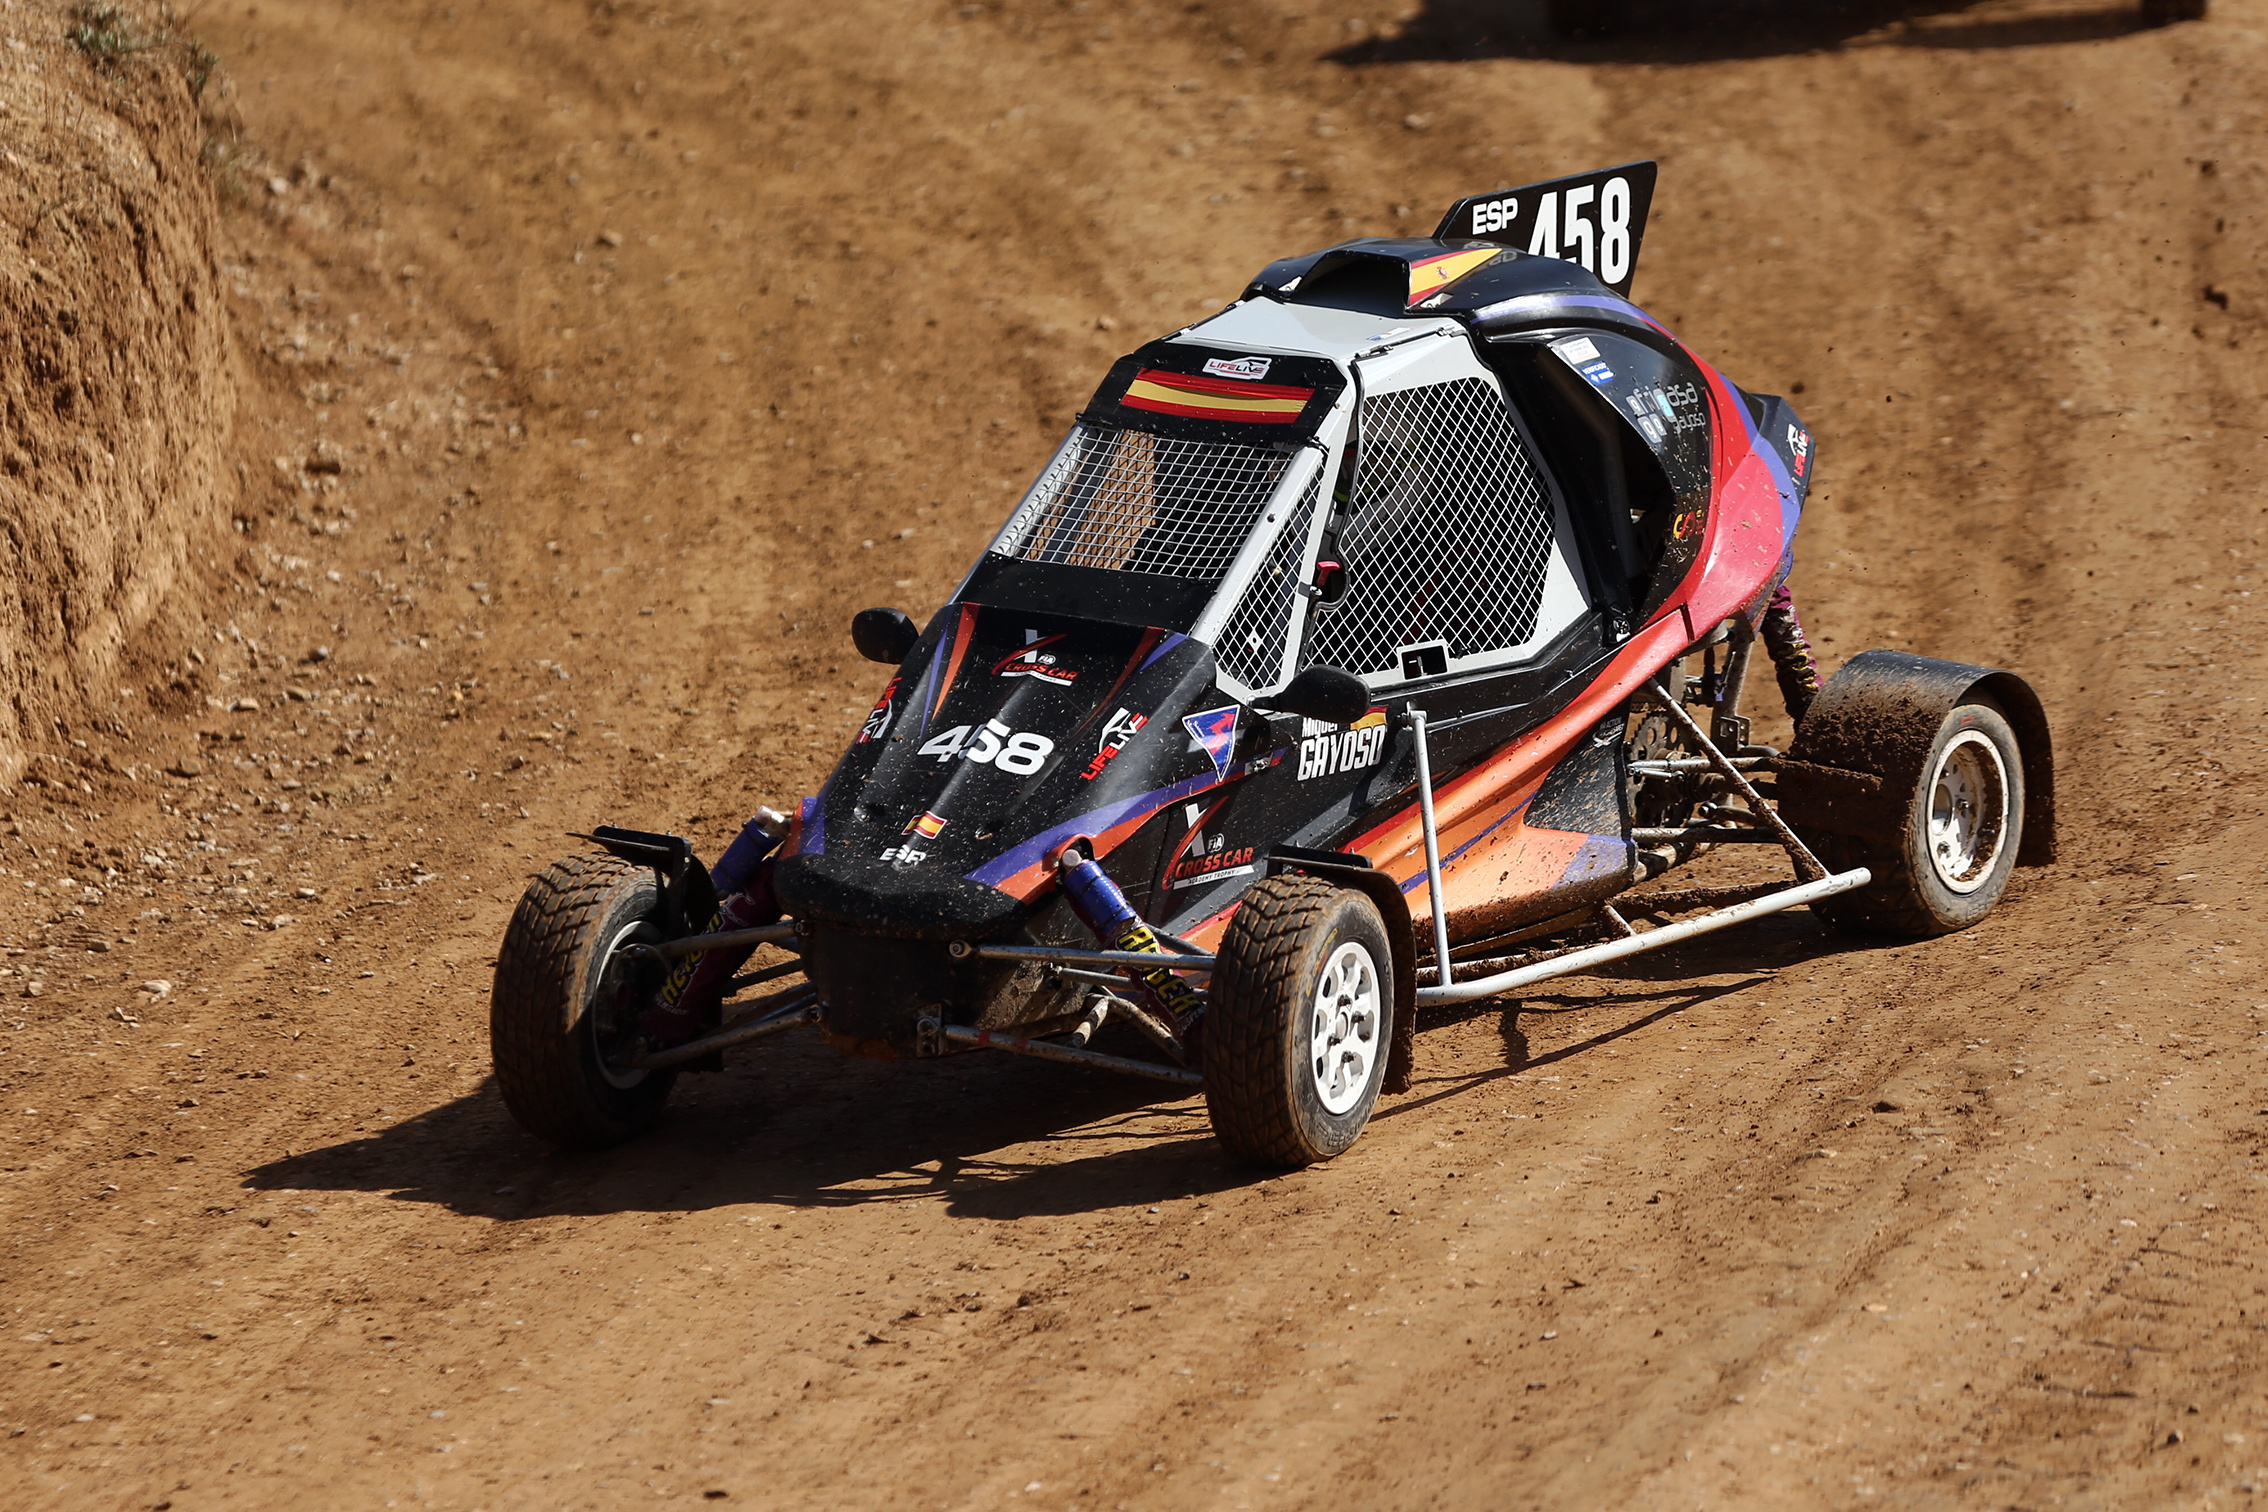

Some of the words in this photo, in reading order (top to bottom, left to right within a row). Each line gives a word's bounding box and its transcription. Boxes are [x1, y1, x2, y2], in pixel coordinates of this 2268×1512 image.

[1472, 197, 1518, 235] ESP
[1527, 177, 1631, 285] 458
[1208, 360, 1265, 375] LIFELIVE
[1004, 662, 1050, 674] CROSS
[1047, 667, 1079, 680] CAR
[917, 718, 1055, 776] 458
[1080, 712, 1149, 781] LIFELIVE
[1296, 724, 1386, 782] GAYOSO
[879, 844, 927, 864] ESP
[1208, 833, 1225, 853] FIA
[1175, 853, 1222, 878] CROSS
[1222, 846, 1254, 867] CAR
[1213, 870, 1236, 880] TROPHY
